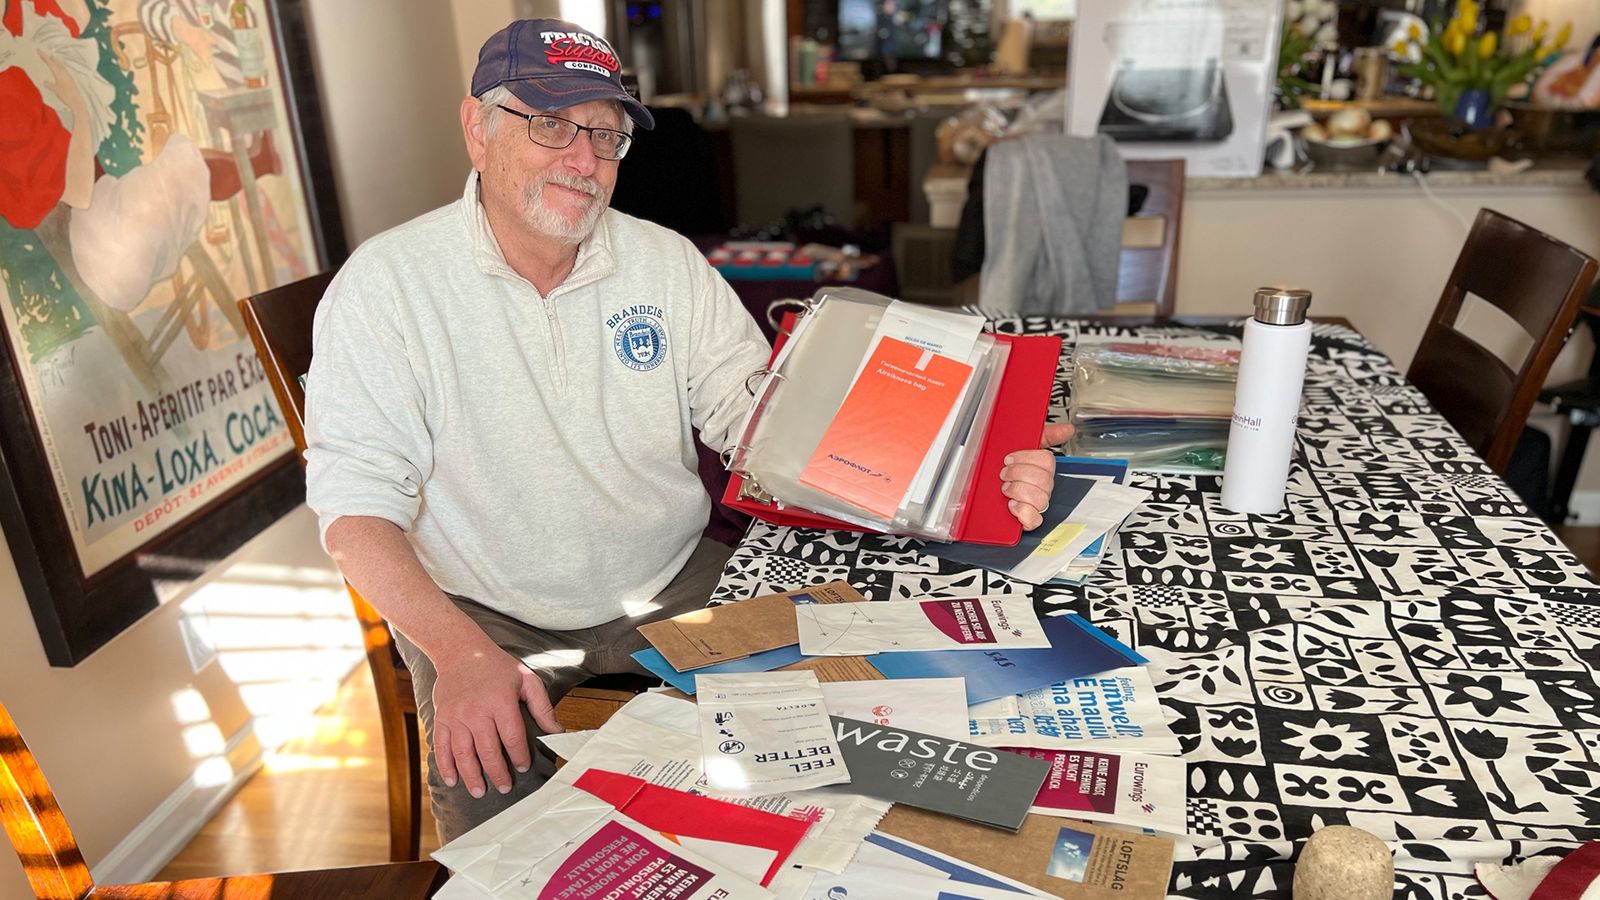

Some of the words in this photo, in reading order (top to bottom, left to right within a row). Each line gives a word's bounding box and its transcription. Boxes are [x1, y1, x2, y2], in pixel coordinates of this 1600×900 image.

[571, 62, 606, 74] COMPANY
[606, 304, 663, 329] BRANDEIS
[912, 381, 927, 391] bag
[827, 453, 872, 475] АЭРОФЛОТ
[991, 600, 1011, 631] Eurowings
[984, 651, 1017, 667] SAS
[1115, 676, 1136, 703] feeling
[776, 703, 808, 711] DELTA
[1099, 678, 1144, 738] unwell?
[1056, 709, 1084, 740] ahau
[754, 745, 832, 763] BETTER
[836, 721, 999, 772] waste
[789, 758, 836, 773] FEEL
[1069, 755, 1080, 763] ES
[1083, 756, 1095, 768] WIR
[1096, 758, 1110, 776] KEINE
[1066, 763, 1079, 782] NICHT
[1078, 768, 1093, 794] NEHMEN
[1128, 762, 1149, 803] Eurowings
[619, 842, 640, 856] WE
[660, 862, 677, 875] ES
[1110, 839, 1135, 891] LOFTSLAG
[631, 872, 664, 899] NICHT
[663, 868, 688, 886] WIR
[665, 874, 699, 900] KEINE
[558, 878, 590, 899] TAKE
